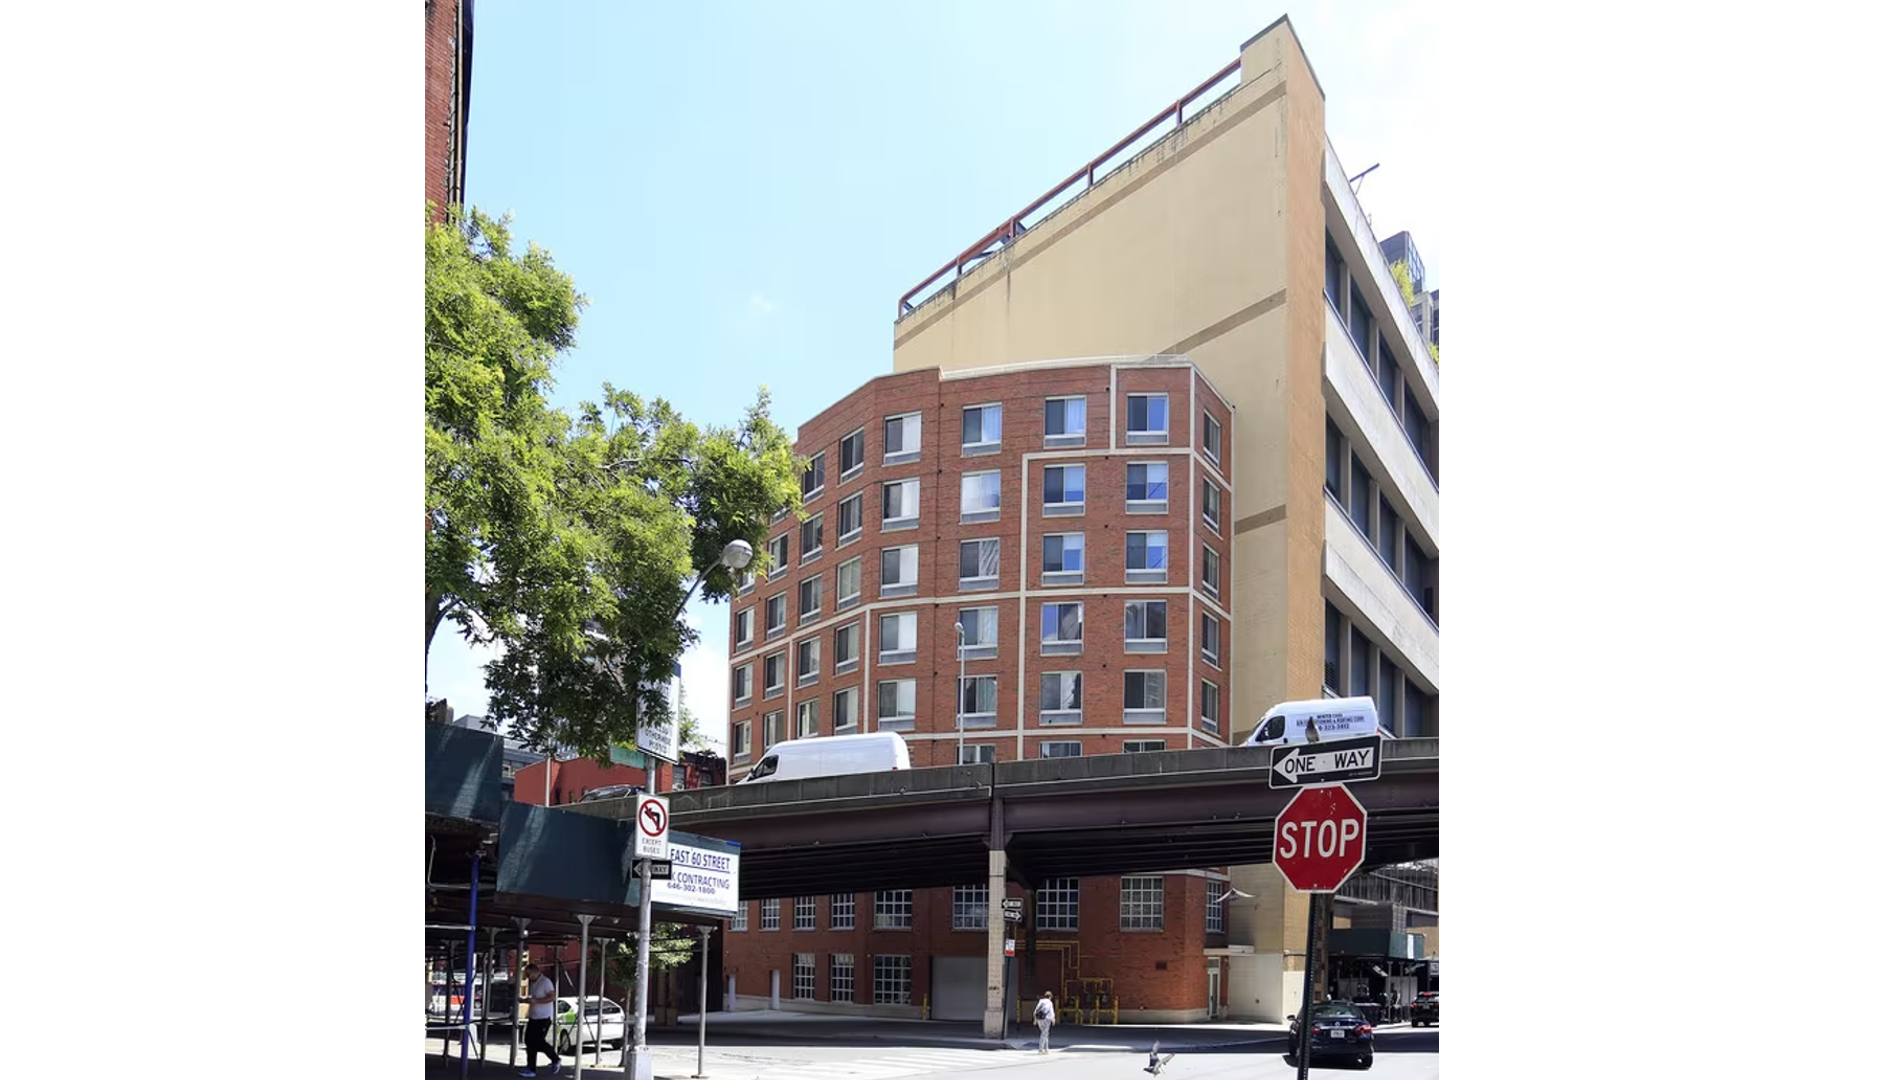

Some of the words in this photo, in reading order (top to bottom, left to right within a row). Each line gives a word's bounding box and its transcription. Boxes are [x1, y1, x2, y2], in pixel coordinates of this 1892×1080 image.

[1285, 756, 1316, 773] ONE
[1334, 750, 1370, 769] WAY
[642, 837, 662, 846] EXCEPT
[1280, 818, 1360, 859] STOP
[643, 845, 660, 854] BUSES
[670, 848, 690, 863] EAST
[690, 852, 702, 866] 60
[703, 854, 731, 870] STREET
[667, 881, 716, 895] 646-302-1800
[677, 871, 730, 890] CONTRACTING
